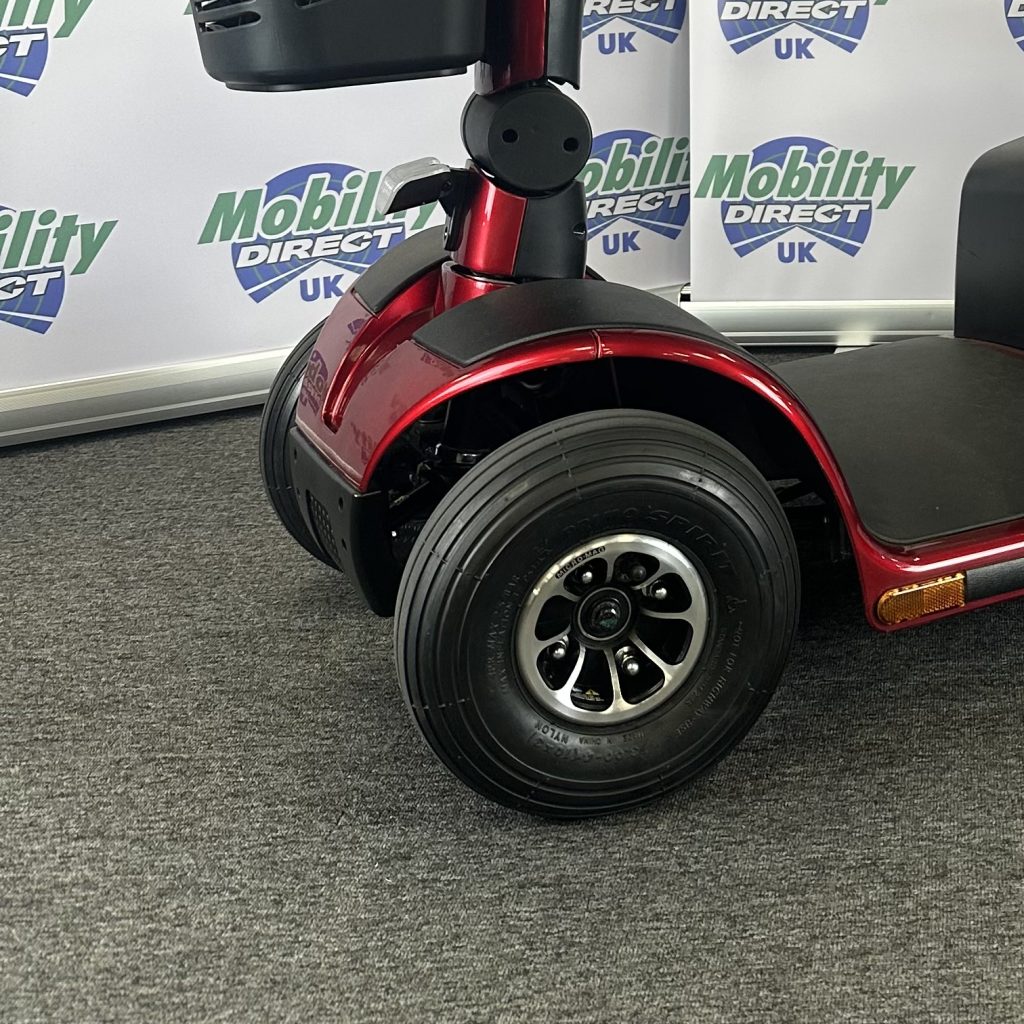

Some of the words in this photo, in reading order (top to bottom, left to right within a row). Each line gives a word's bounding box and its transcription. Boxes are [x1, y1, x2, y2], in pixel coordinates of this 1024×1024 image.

[718, 0, 866, 20] DIRECT
[596, 32, 636, 55] UK
[774, 38, 813, 60] UK
[693, 147, 913, 212] Mobility
[724, 204, 870, 225] DIRECT
[235, 228, 405, 268] DIRECT
[602, 231, 638, 256] UK
[776, 240, 816, 264] UK
[299, 274, 346, 304] UK
[534, 721, 569, 745] NYLON
